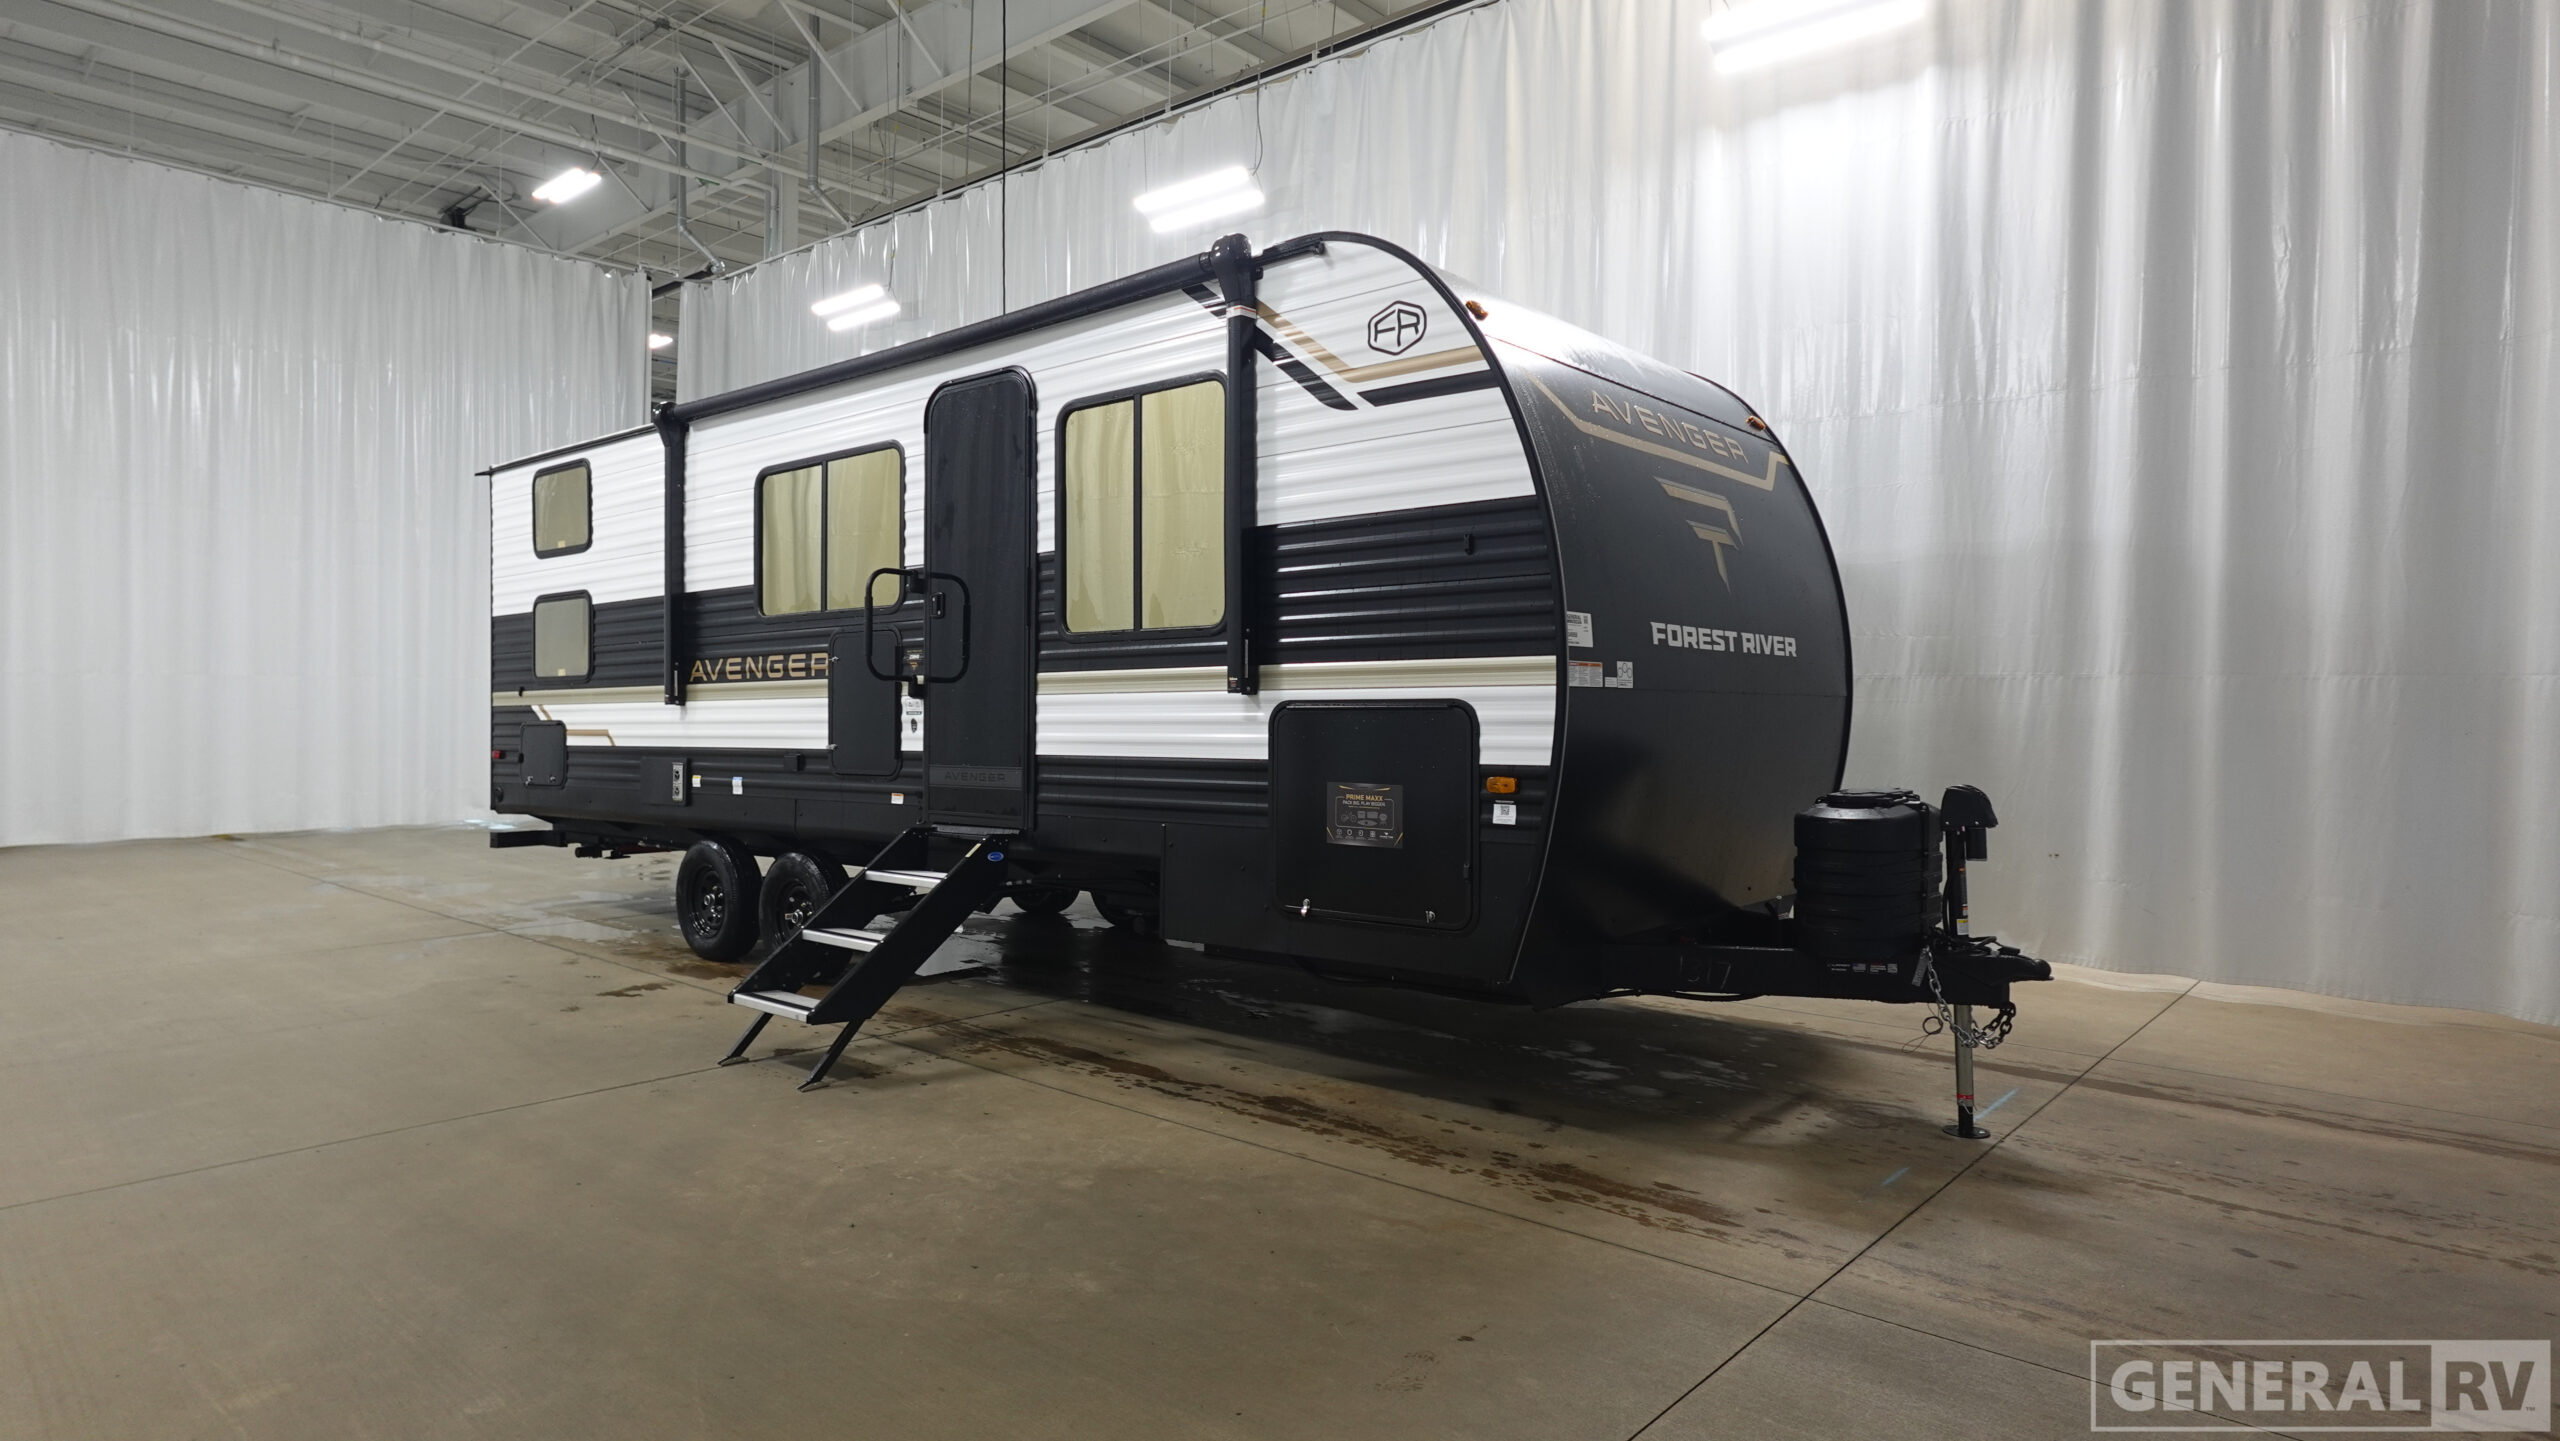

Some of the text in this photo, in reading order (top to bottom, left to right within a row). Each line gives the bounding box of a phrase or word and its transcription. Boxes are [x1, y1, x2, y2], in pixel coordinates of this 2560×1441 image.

[1592, 390, 1749, 464] AVENGER
[1650, 621, 1797, 658] FOREST RIVER
[689, 652, 829, 682] AVENGER
[944, 769, 1007, 783] AVENGER
[1345, 793, 1384, 802] PRIME MAXX
